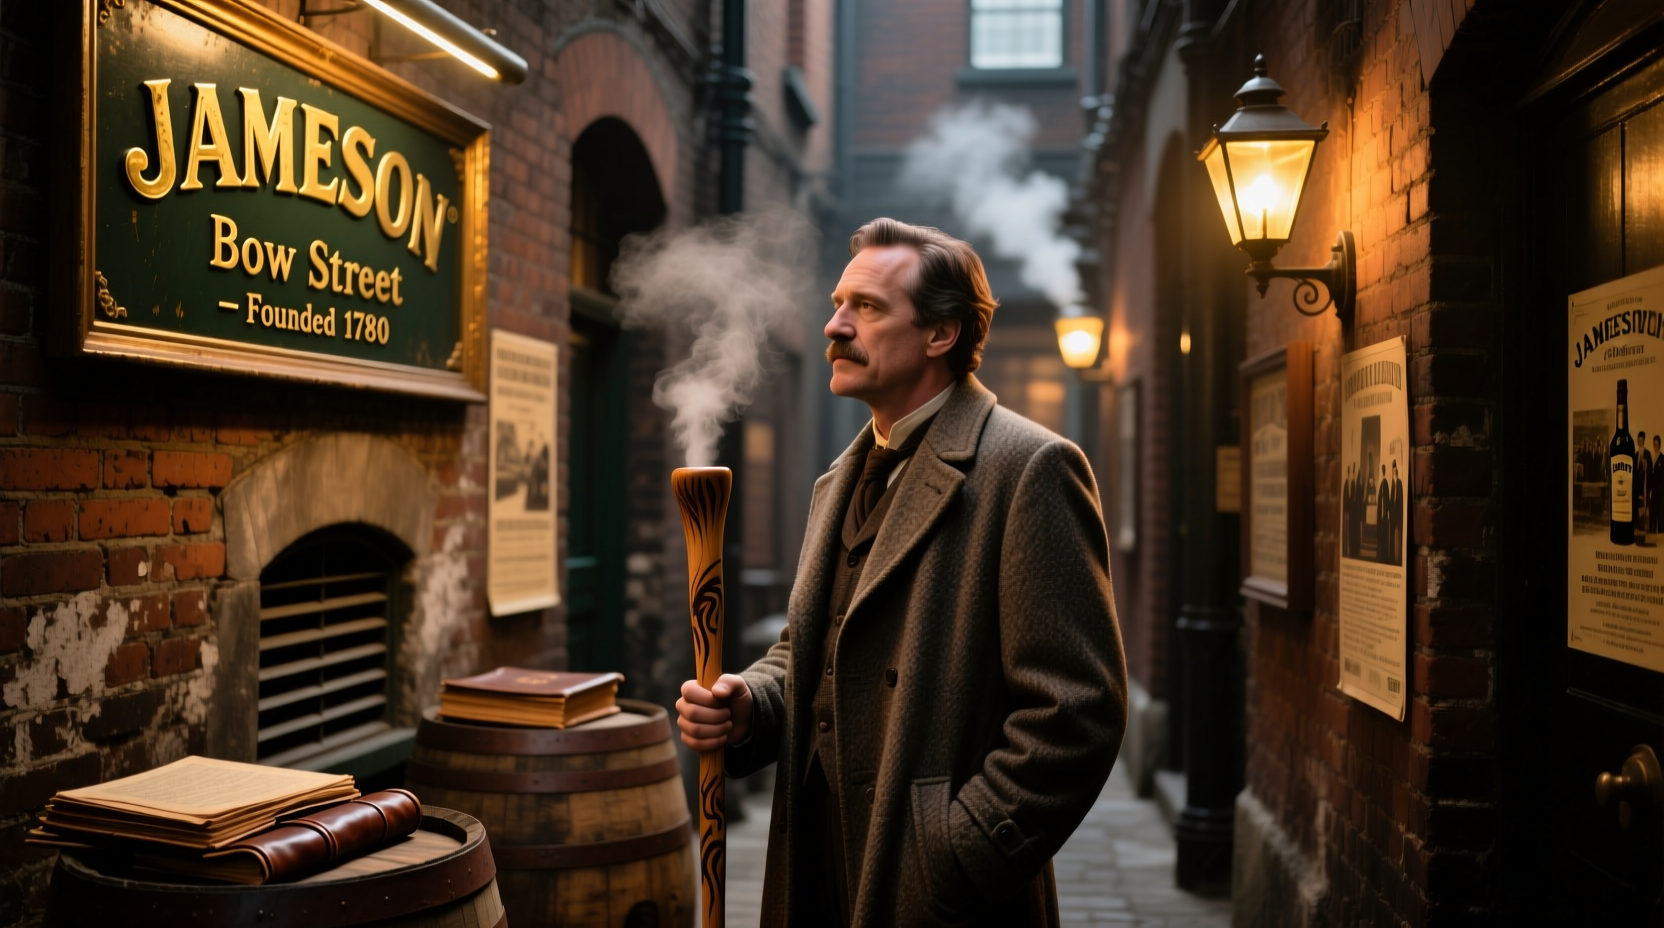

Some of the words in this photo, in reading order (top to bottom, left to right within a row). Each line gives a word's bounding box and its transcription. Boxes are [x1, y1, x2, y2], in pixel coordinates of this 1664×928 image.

[126, 79, 449, 273] JAMESON
[210, 213, 297, 282] Bow
[308, 239, 404, 306] Street
[245, 292, 337, 338] Founded
[343, 310, 390, 346] 1780
